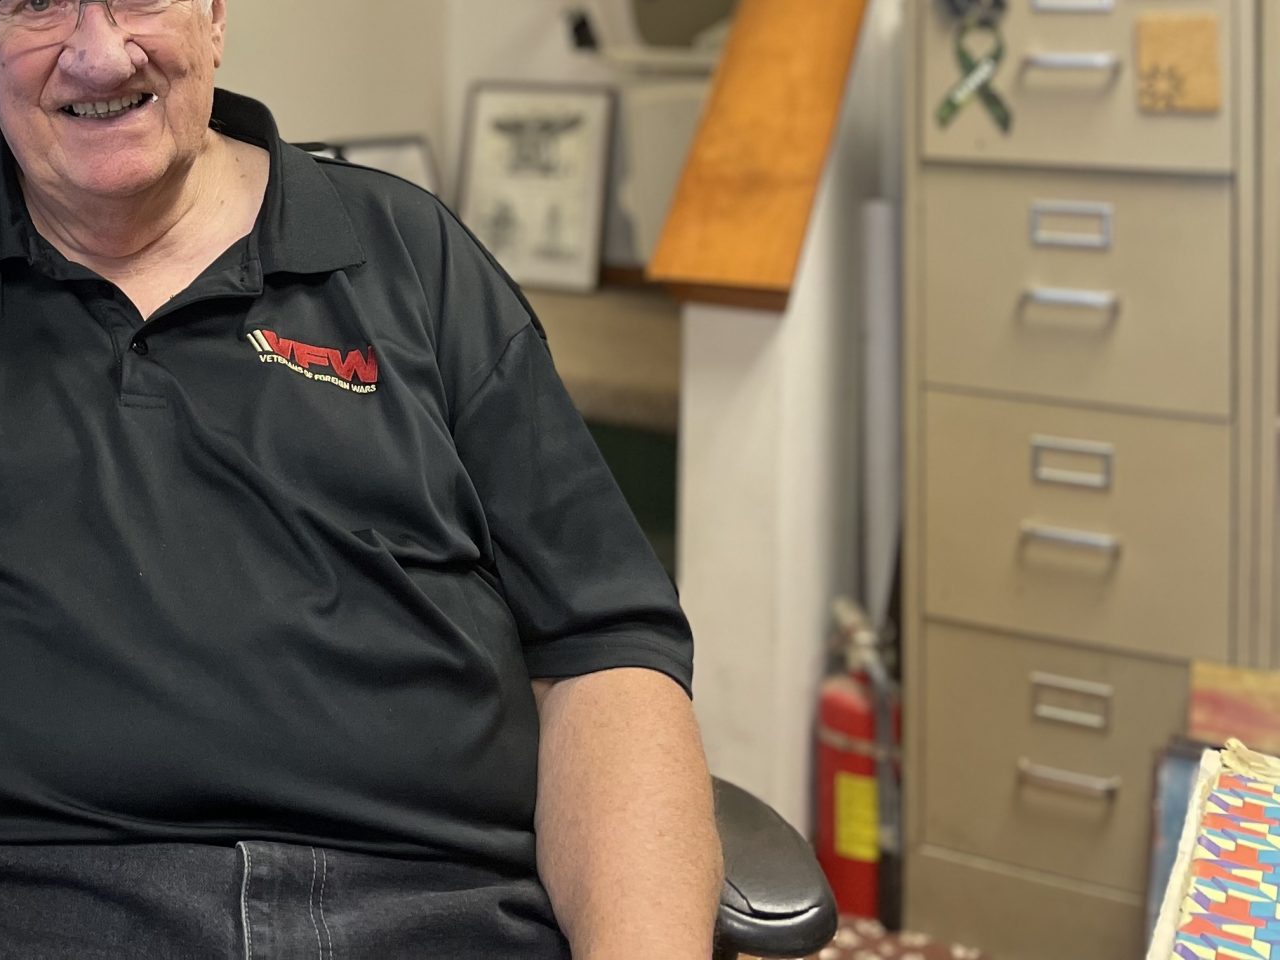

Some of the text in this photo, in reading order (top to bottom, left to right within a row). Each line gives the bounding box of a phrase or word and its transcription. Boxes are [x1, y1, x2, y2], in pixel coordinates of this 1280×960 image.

[259, 353, 304, 374] VETERANS
[314, 373, 350, 391] FOREIGN
[350, 384, 377, 394] WARS
[261, 329, 379, 383] VFW
